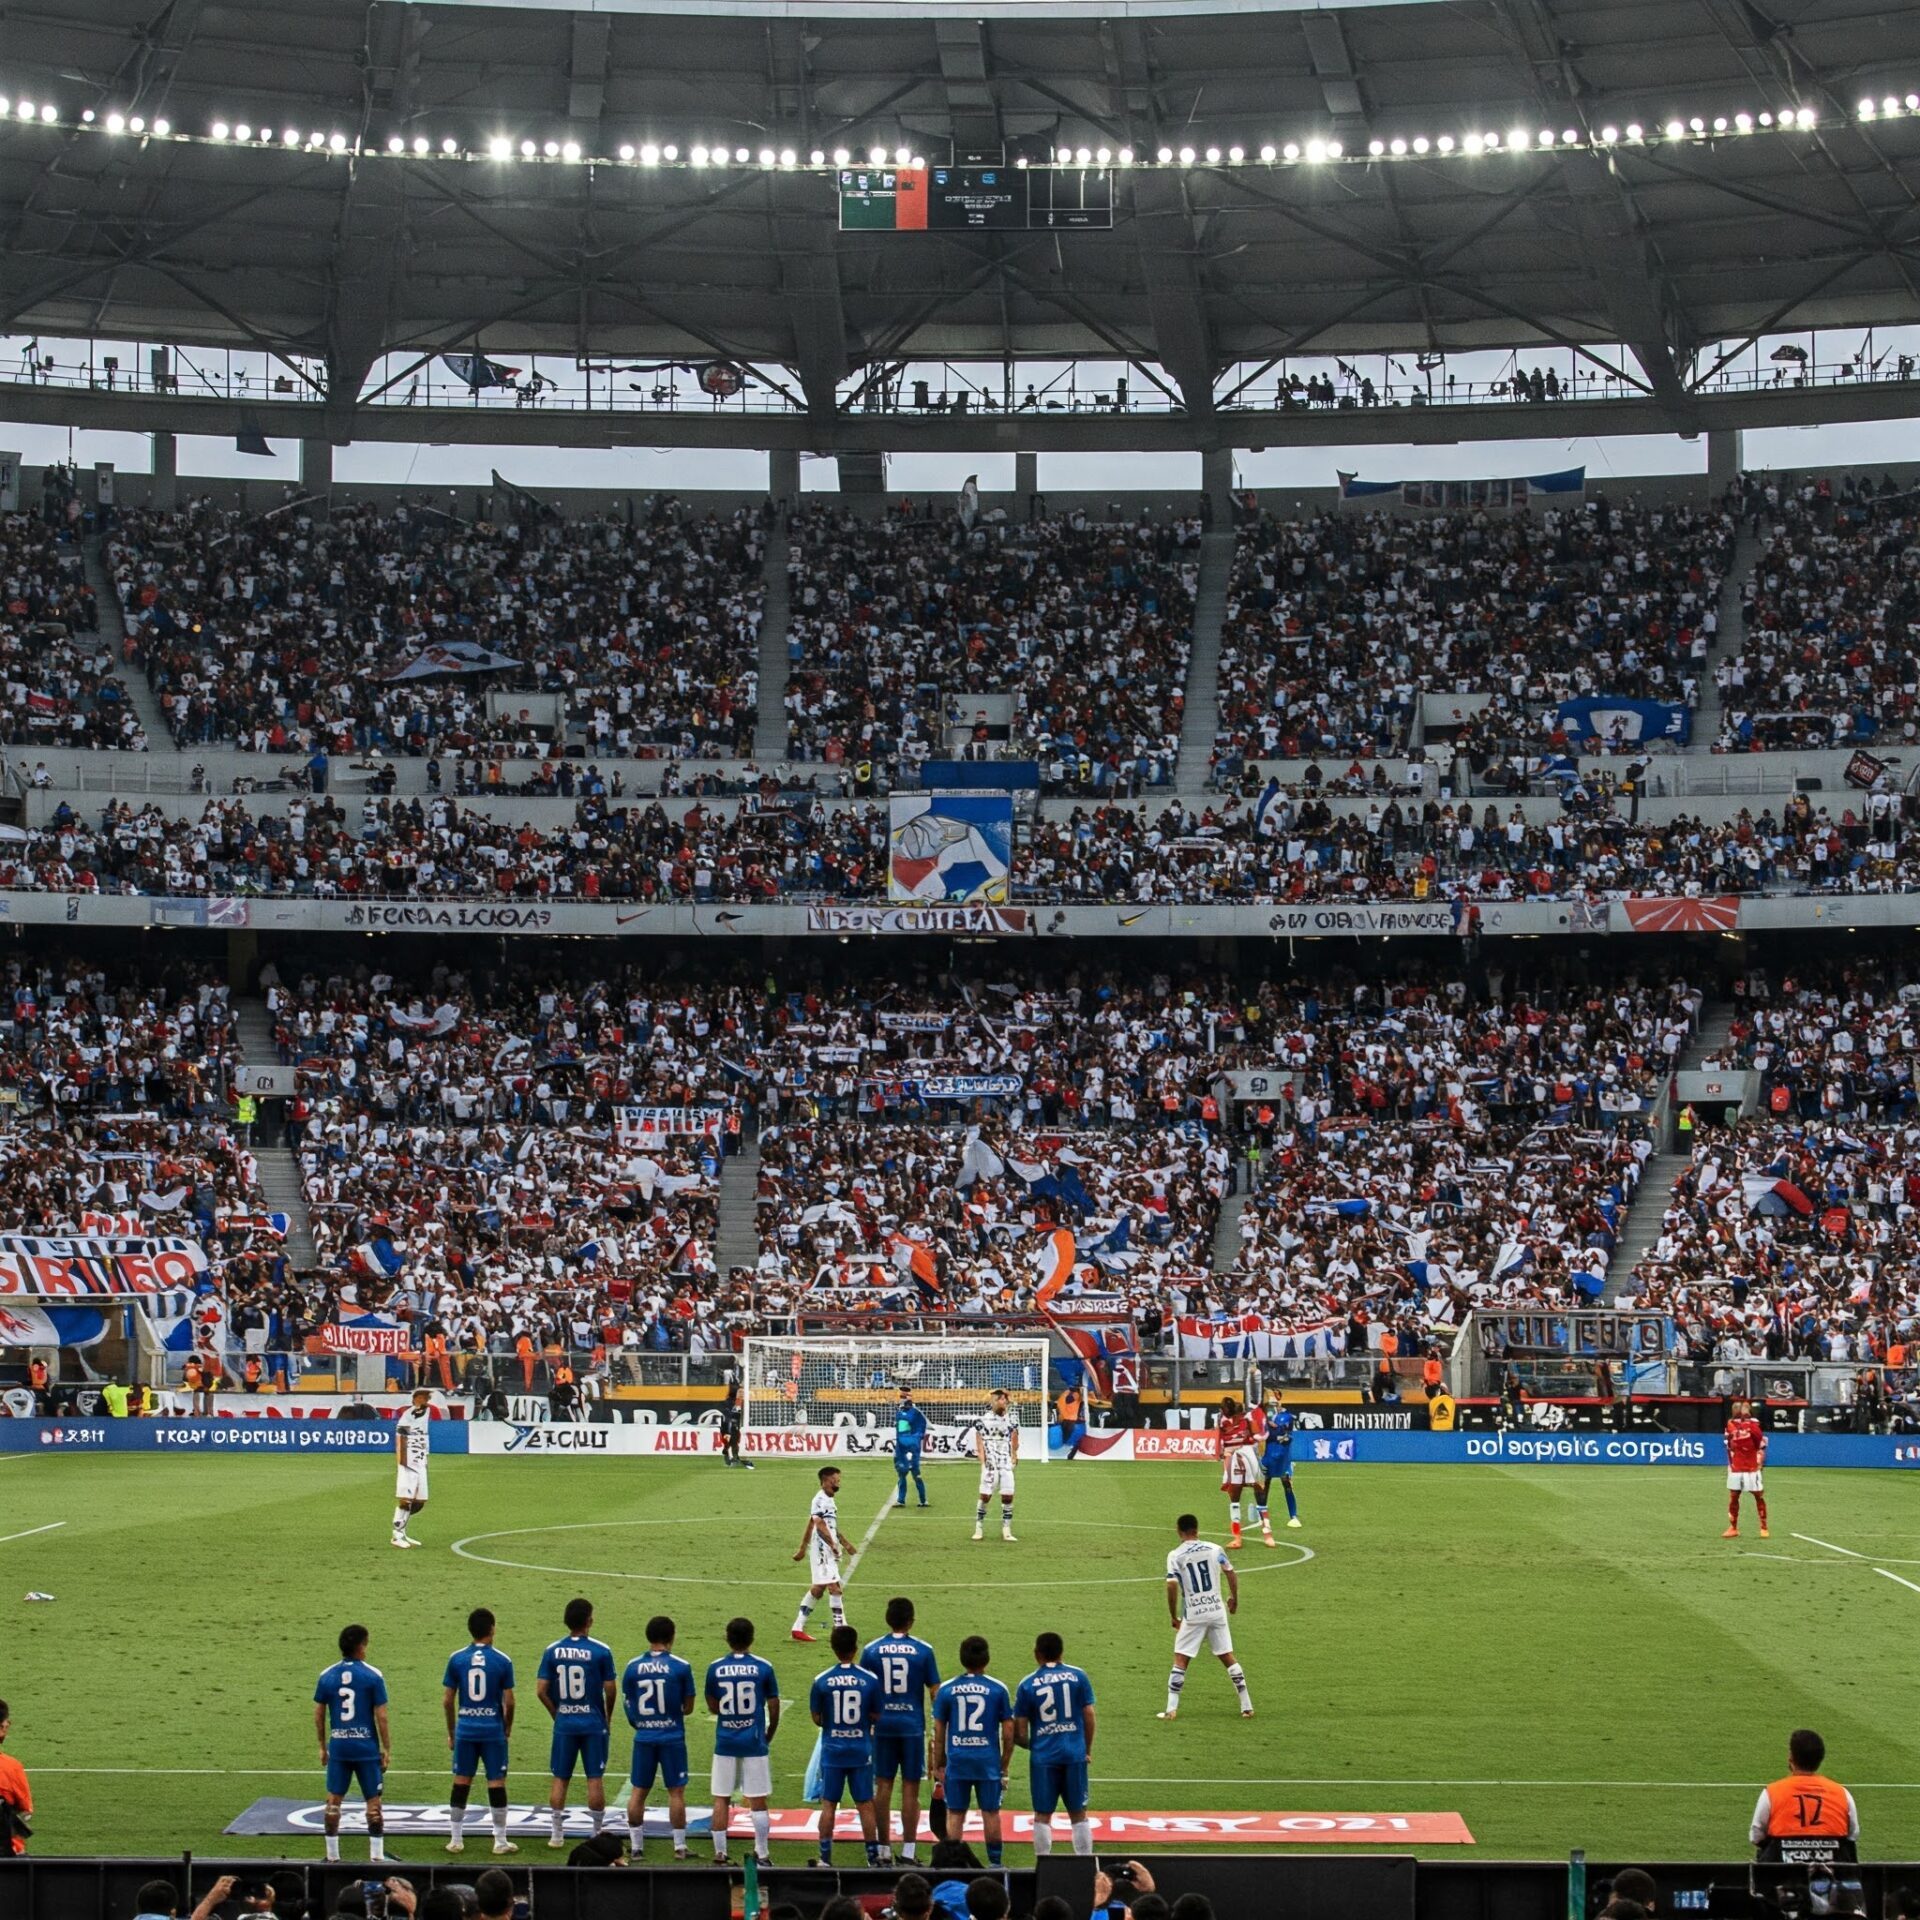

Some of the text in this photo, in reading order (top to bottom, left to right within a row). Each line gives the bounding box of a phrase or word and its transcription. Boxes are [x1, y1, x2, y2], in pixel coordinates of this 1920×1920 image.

[556, 1664, 586, 1700] 18
[881, 1657, 909, 1695] 13
[338, 1687, 356, 1722] 3
[637, 1679, 666, 1716] 21
[832, 1689, 862, 1725] 18
[956, 1695, 986, 1733] 12
[1035, 1682, 1072, 1723] 21
